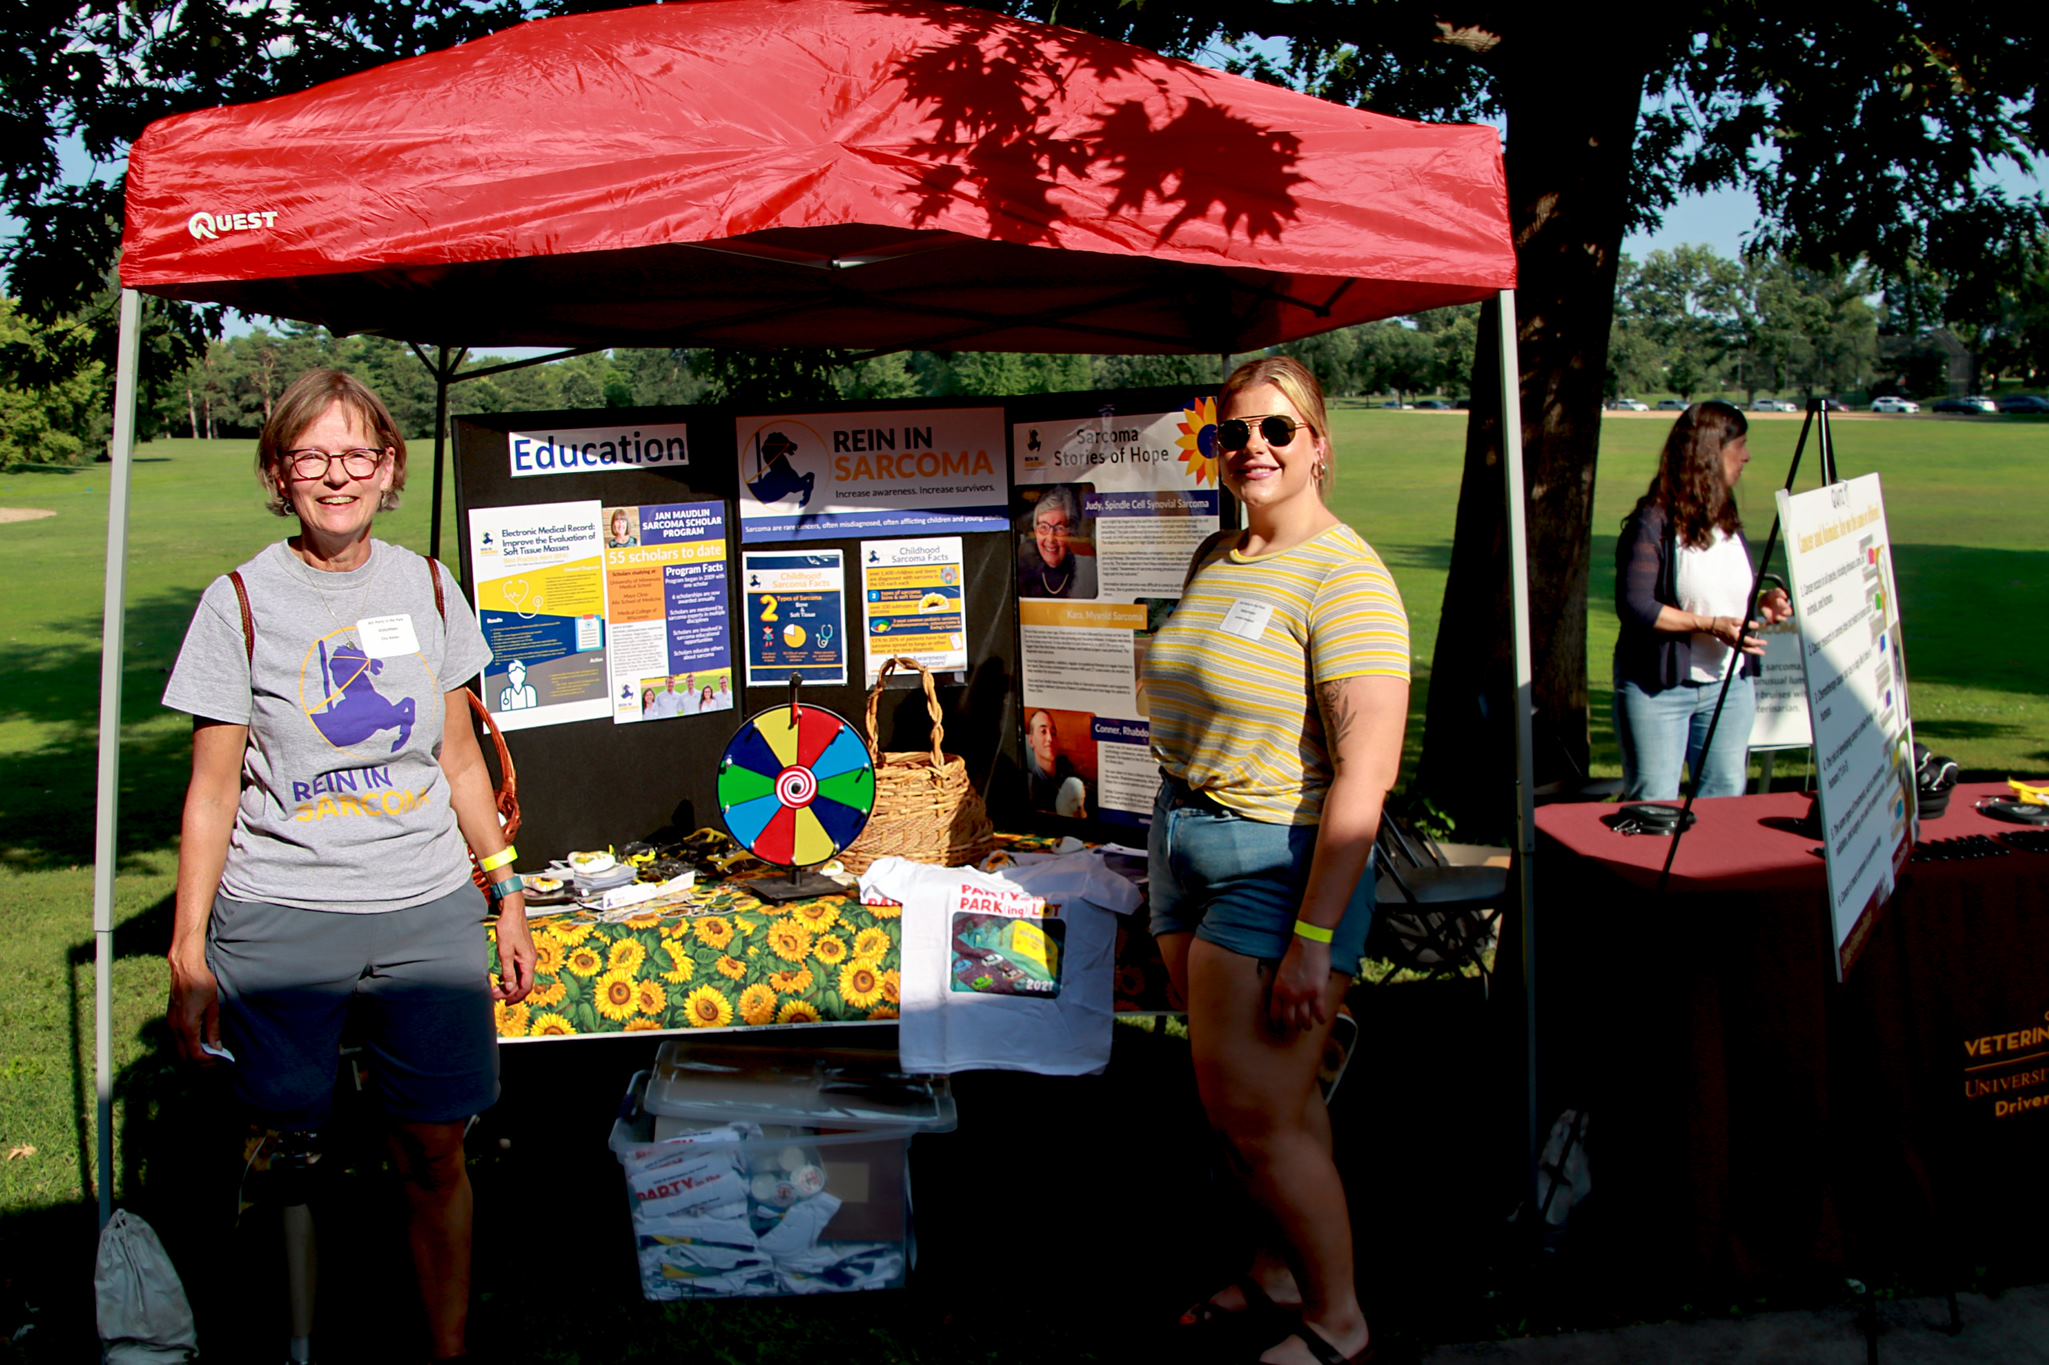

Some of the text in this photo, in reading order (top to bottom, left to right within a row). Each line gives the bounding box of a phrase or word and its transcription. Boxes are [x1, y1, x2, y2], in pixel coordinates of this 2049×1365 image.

[188, 211, 279, 239] QUEST
[833, 426, 932, 453] REIN IN
[1077, 428, 1139, 444] Sarcoma
[514, 431, 686, 471] Education
[1054, 450, 1105, 466] Stories
[1111, 448, 1125, 463] of
[1131, 447, 1169, 465] Hope
[835, 449, 995, 482] SARCOMA
[836, 483, 995, 499] Increase awareness. Increase survivors.
[1105, 500, 1130, 511] Spindle
[1131, 500, 1146, 509] Cell
[1147, 499, 1177, 510] Synovial
[1177, 499, 1210, 509] Sarcoma
[655, 509, 710, 521] JAN MAUDLIN
[502, 523, 595, 538] Electronic Medical Record:
[642, 517, 722, 531] SARCOMA SCHOLAR
[502, 531, 596, 548] Improve the Evaluation of
[663, 527, 705, 538] PROGRAM
[503, 547, 519, 556] Soft
[520, 546, 542, 555] Tissue
[543, 544, 570, 553] Masses
[609, 545, 722, 565] 55 scholars to date
[891, 553, 949, 563] Sarcoma Facts
[899, 546, 940, 555] Childhood
[666, 563, 724, 577] Program Facts
[760, 594, 779, 623] 2
[292, 767, 393, 802] REIN IN
[1965, 1068, 2049, 1098] UNIVERSI
